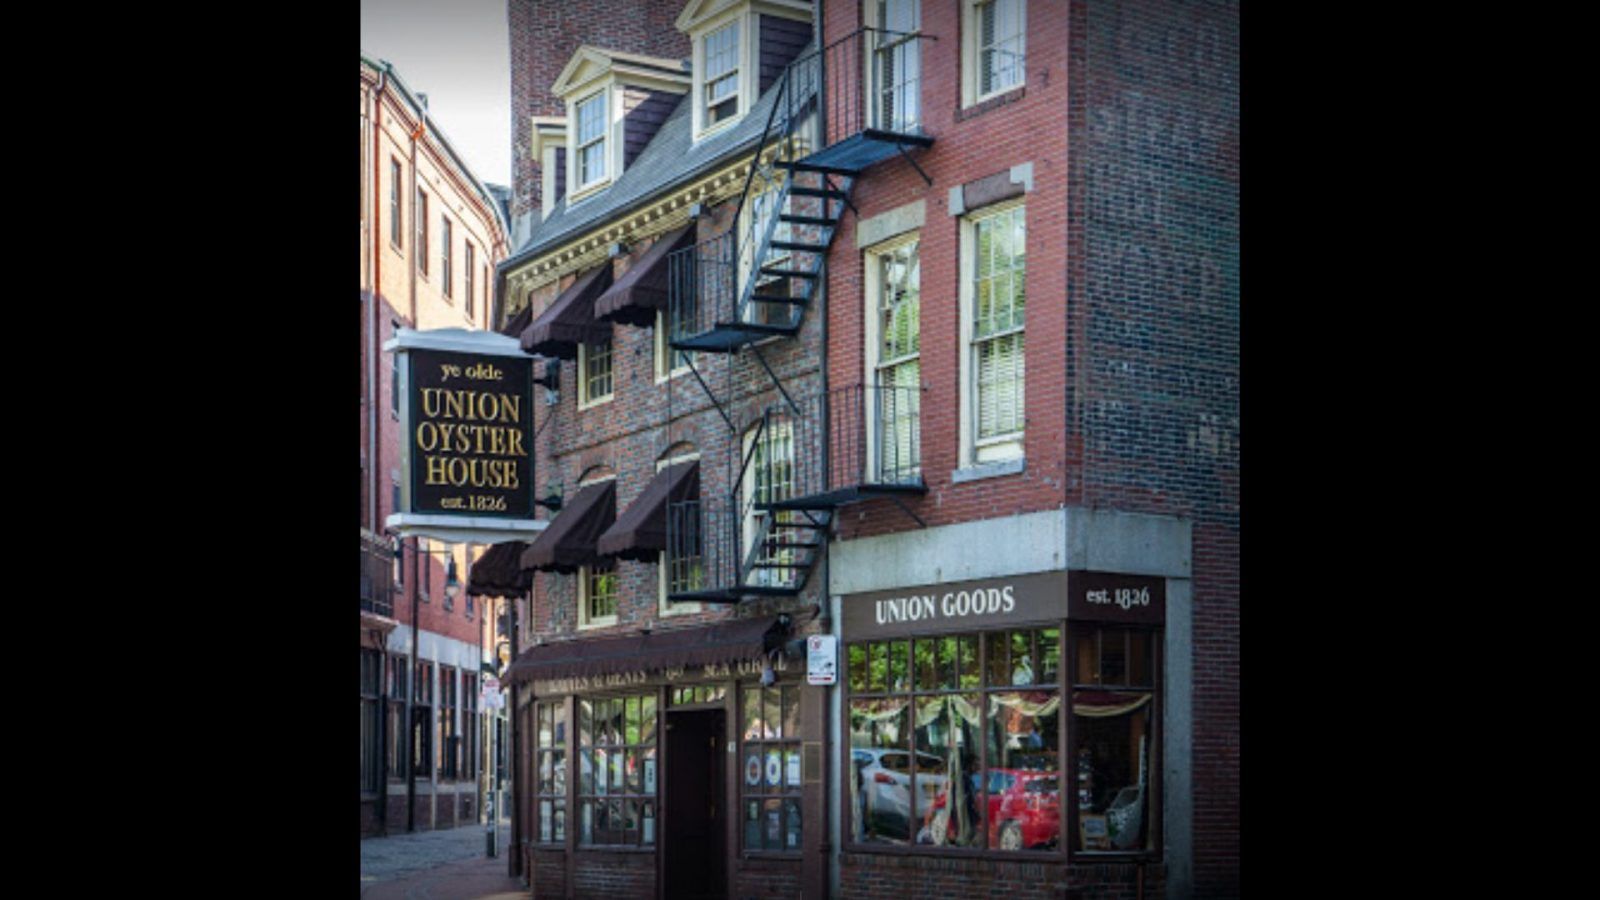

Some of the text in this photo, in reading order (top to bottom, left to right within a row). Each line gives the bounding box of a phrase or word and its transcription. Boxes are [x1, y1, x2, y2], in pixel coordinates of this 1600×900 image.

[440, 362, 503, 382] ye olde
[420, 387, 521, 423] UNION
[416, 421, 528, 456] OYSTER
[425, 455, 519, 489] HOUSE
[875, 586, 1015, 624] UNION GOODS
[1086, 587, 1150, 609] est. 1826
